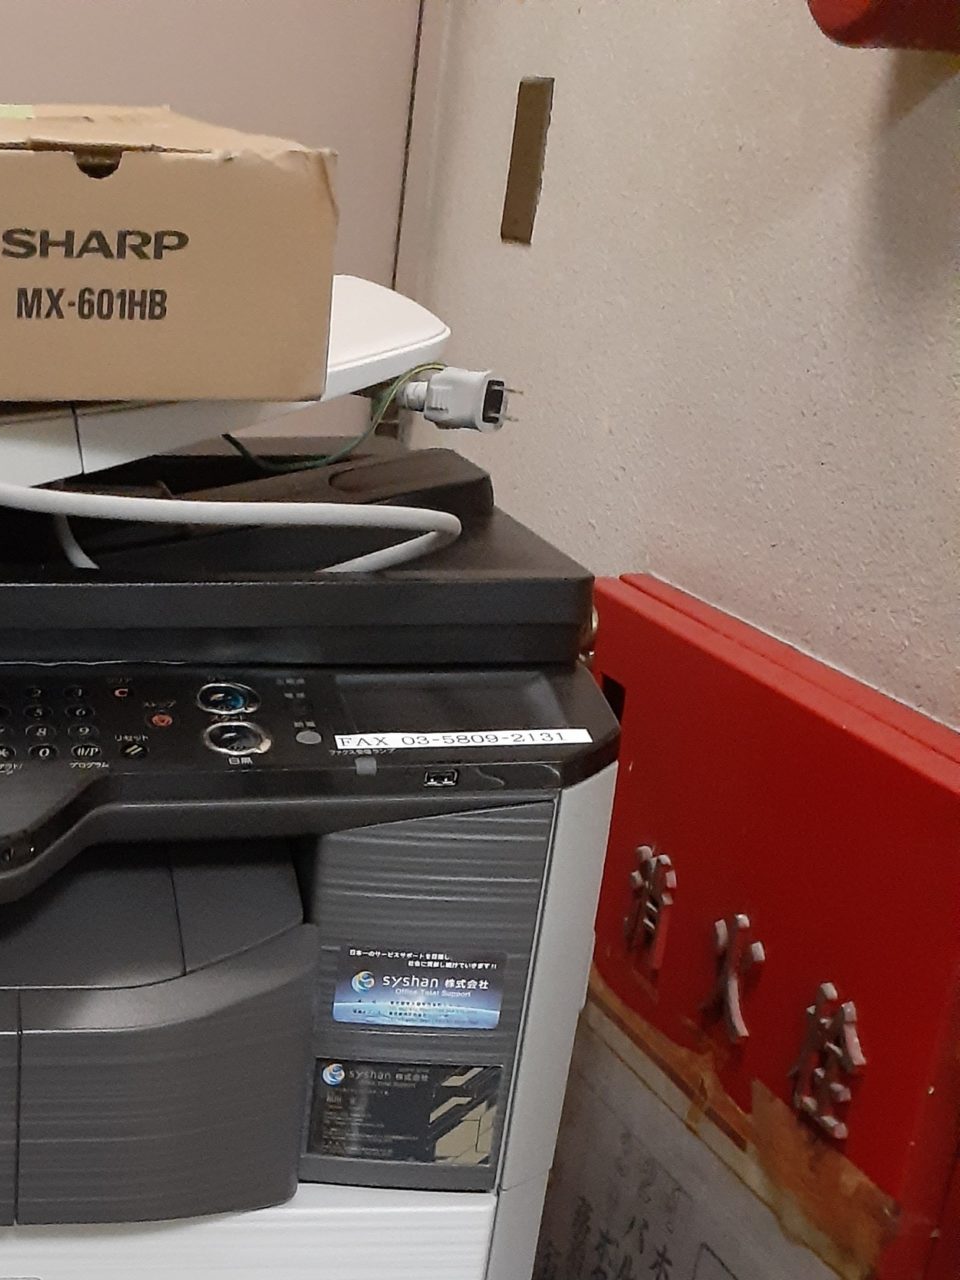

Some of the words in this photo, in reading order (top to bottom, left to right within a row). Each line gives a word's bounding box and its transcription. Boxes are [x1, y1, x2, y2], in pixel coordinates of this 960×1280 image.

[1, 229, 190, 260] SHARP
[15, 287, 168, 321] MX-601HB
[337, 736, 390, 747] FAX
[401, 731, 567, 747] 03-5809-2131
[382, 975, 440, 988] syshan
[444, 978, 490, 991] 株式会社
